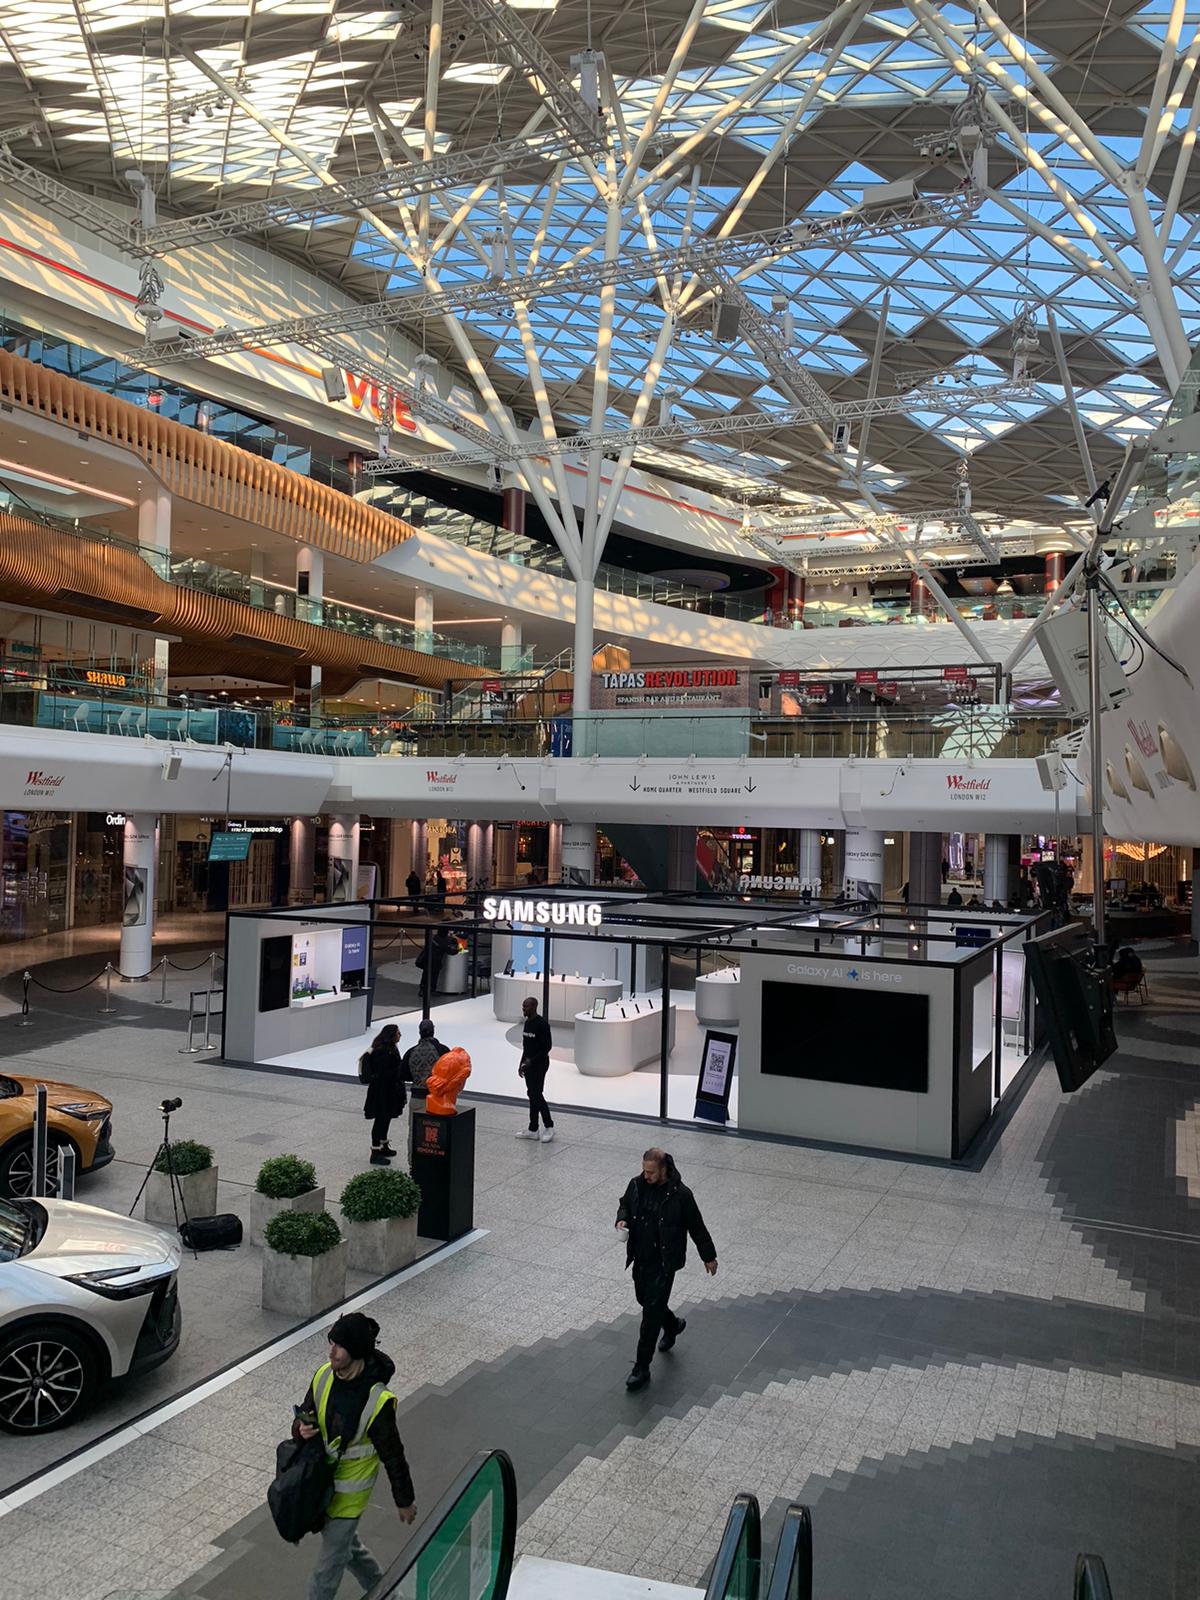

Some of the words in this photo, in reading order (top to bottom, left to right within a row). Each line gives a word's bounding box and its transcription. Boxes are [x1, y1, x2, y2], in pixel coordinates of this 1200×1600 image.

[617, 695, 645, 704] SPANISH
[677, 693, 720, 703] RESTAURANT
[25, 770, 65, 787] Westfield
[426, 770, 458, 784] Westfield
[946, 774, 992, 790] Westfield
[269, 826, 283, 834] Shop
[483, 897, 602, 927] SAMSUNG
[787, 963, 829, 979] Galaxy
[832, 967, 843, 978] AI
[873, 970, 903, 983] here
